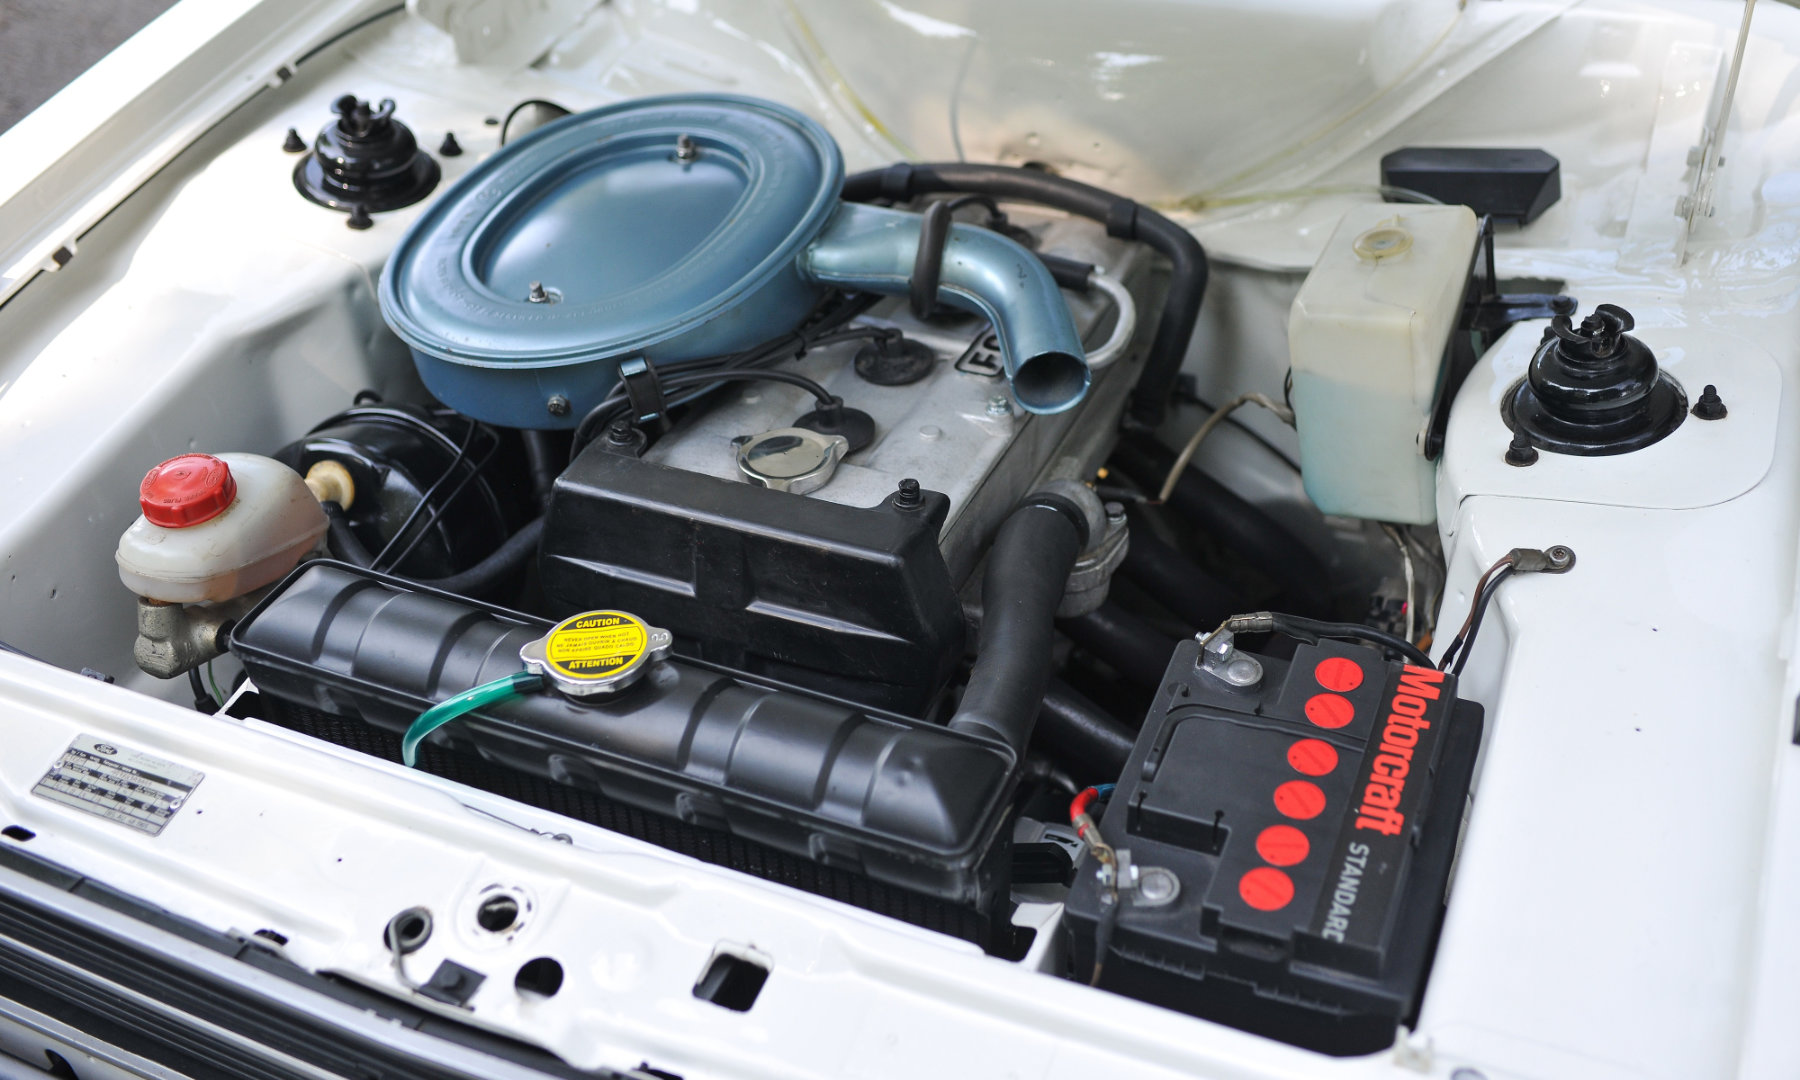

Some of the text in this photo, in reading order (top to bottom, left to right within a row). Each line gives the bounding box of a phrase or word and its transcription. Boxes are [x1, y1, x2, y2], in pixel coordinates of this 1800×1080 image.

[576, 617, 620, 629] CAUTION
[568, 657, 624, 669] ATTENTION
[1355, 664, 1446, 836] Motorcraft
